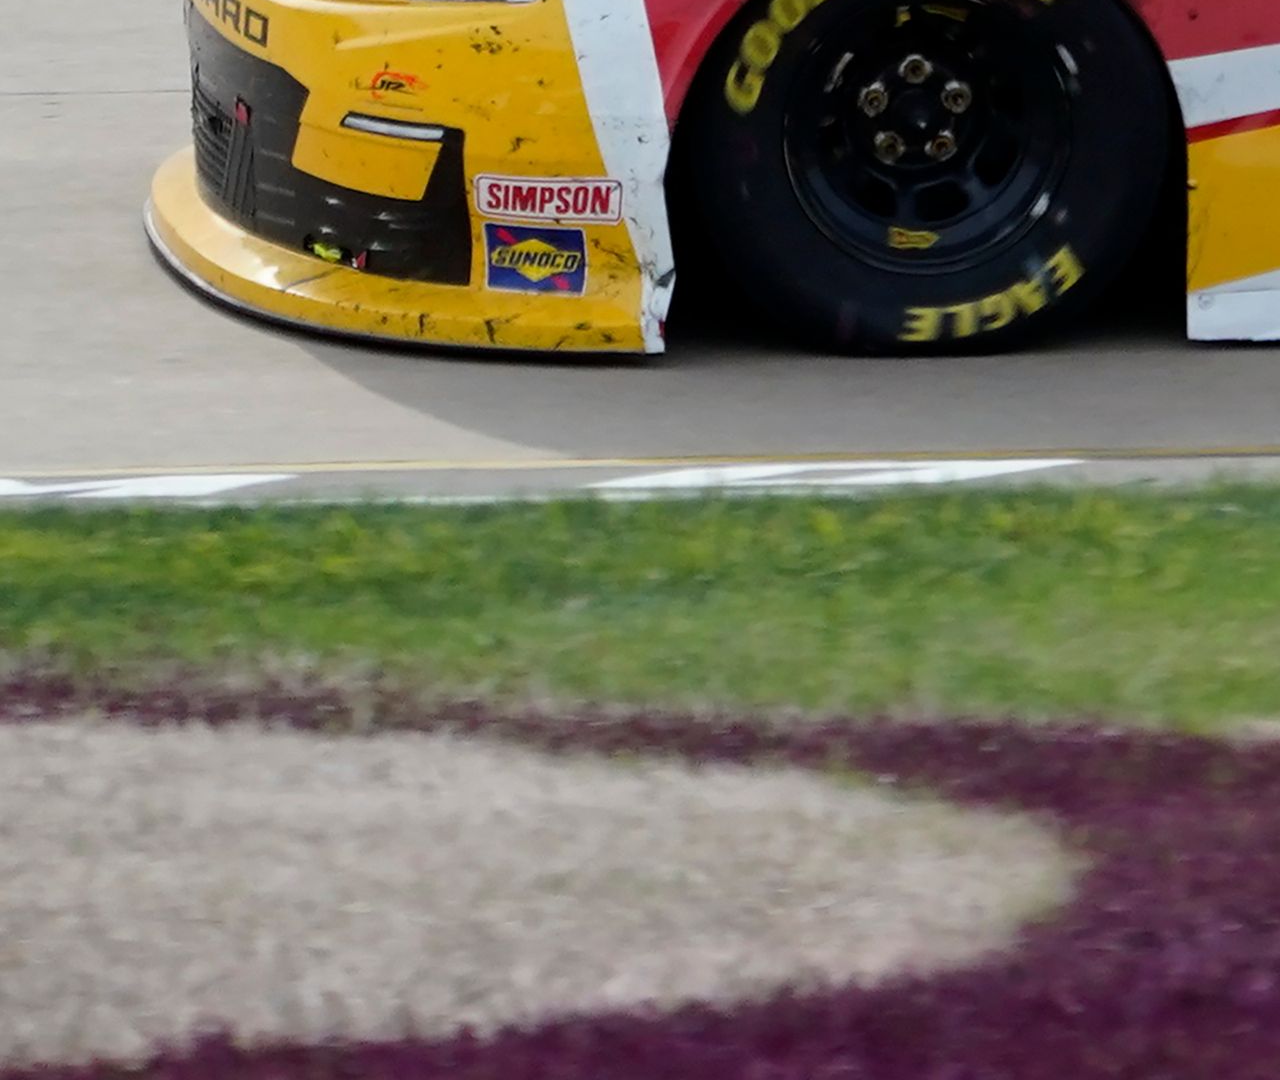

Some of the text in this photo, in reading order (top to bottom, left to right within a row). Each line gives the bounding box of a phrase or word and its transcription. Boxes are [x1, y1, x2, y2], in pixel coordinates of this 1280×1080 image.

[486, 181, 613, 215] SIMPSON
[493, 245, 582, 274] SUNOCO
[897, 244, 1087, 343] EAGLE
